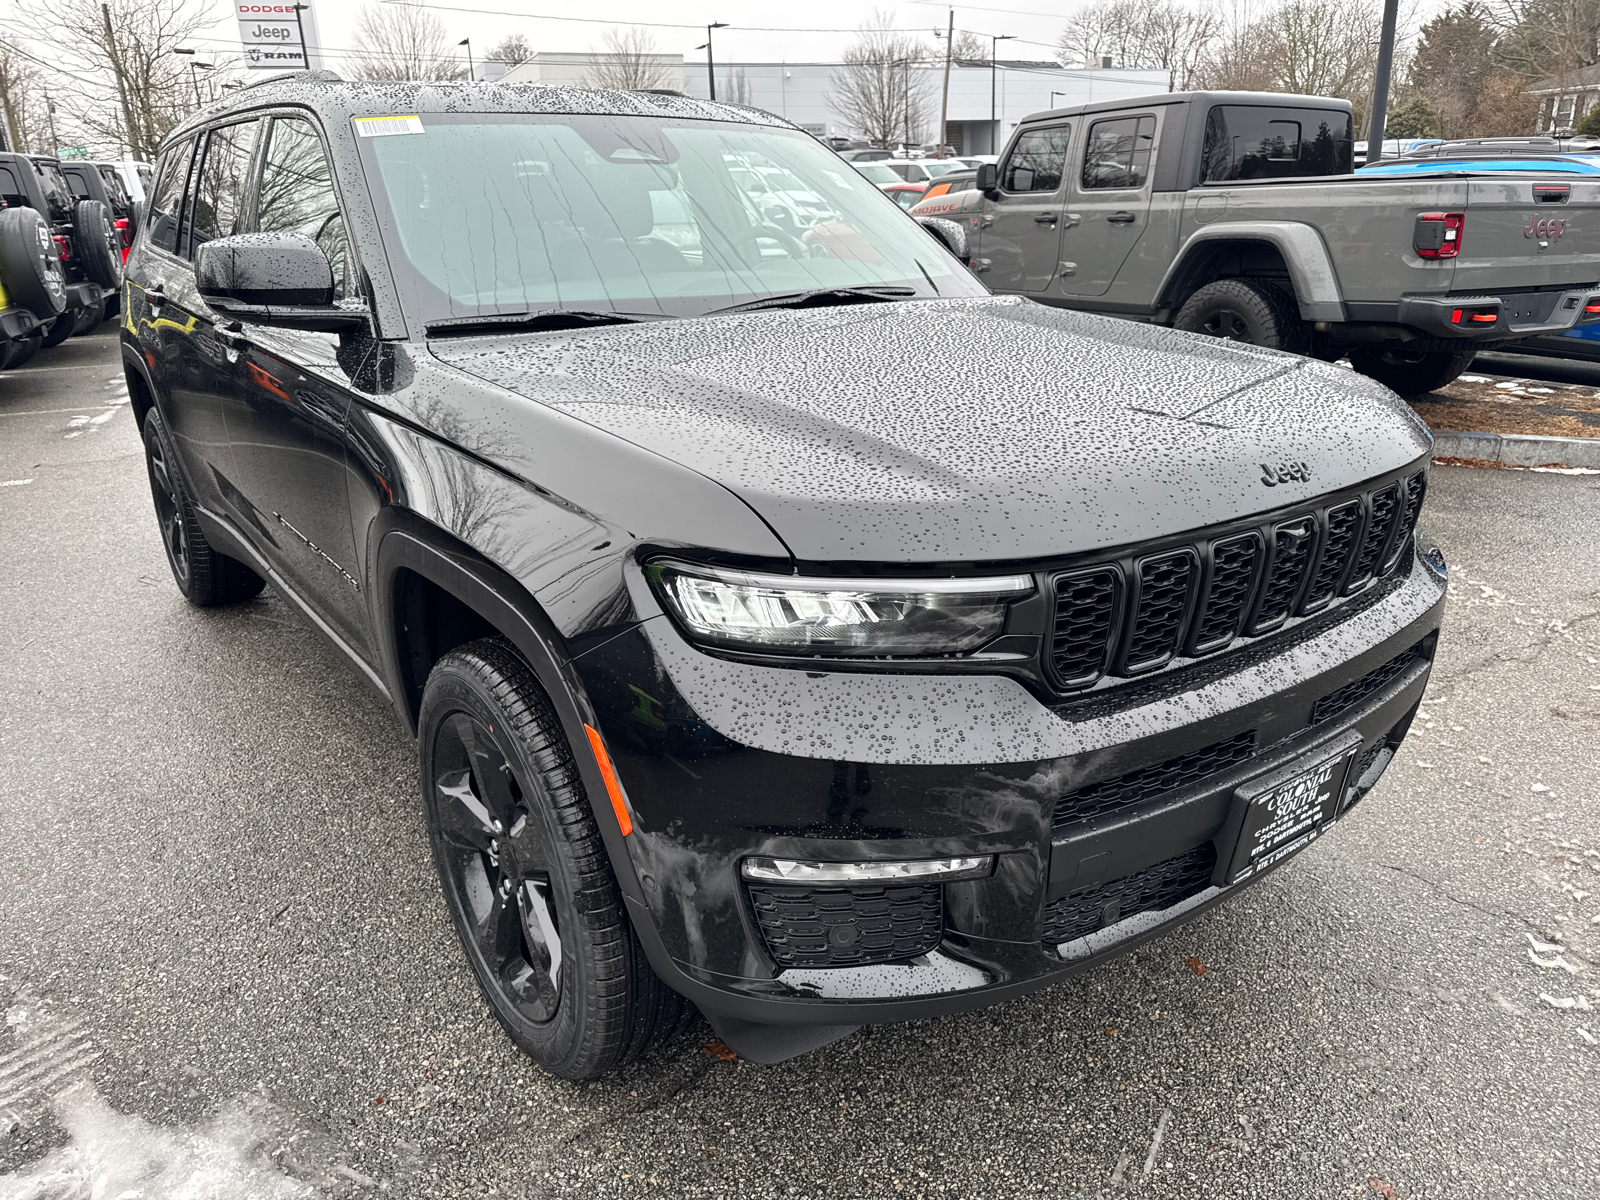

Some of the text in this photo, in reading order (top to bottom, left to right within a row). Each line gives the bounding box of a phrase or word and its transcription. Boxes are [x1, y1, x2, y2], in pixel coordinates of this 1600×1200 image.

[239, 5, 295, 13] DODGE
[252, 24, 290, 40] Jeep
[264, 52, 302, 60] RAM
[911, 203, 957, 216] MOJAVE
[1523, 213, 1565, 243] Jeep
[1259, 461, 1312, 488] Jeep
[1268, 768, 1332, 811] COLONIAL
[1274, 786, 1319, 820] SOUTH
[1254, 792, 1330, 837] CHRYSLER Jeep
[1259, 805, 1321, 843] DODGE RAM
[1313, 812, 1323, 821] MA
